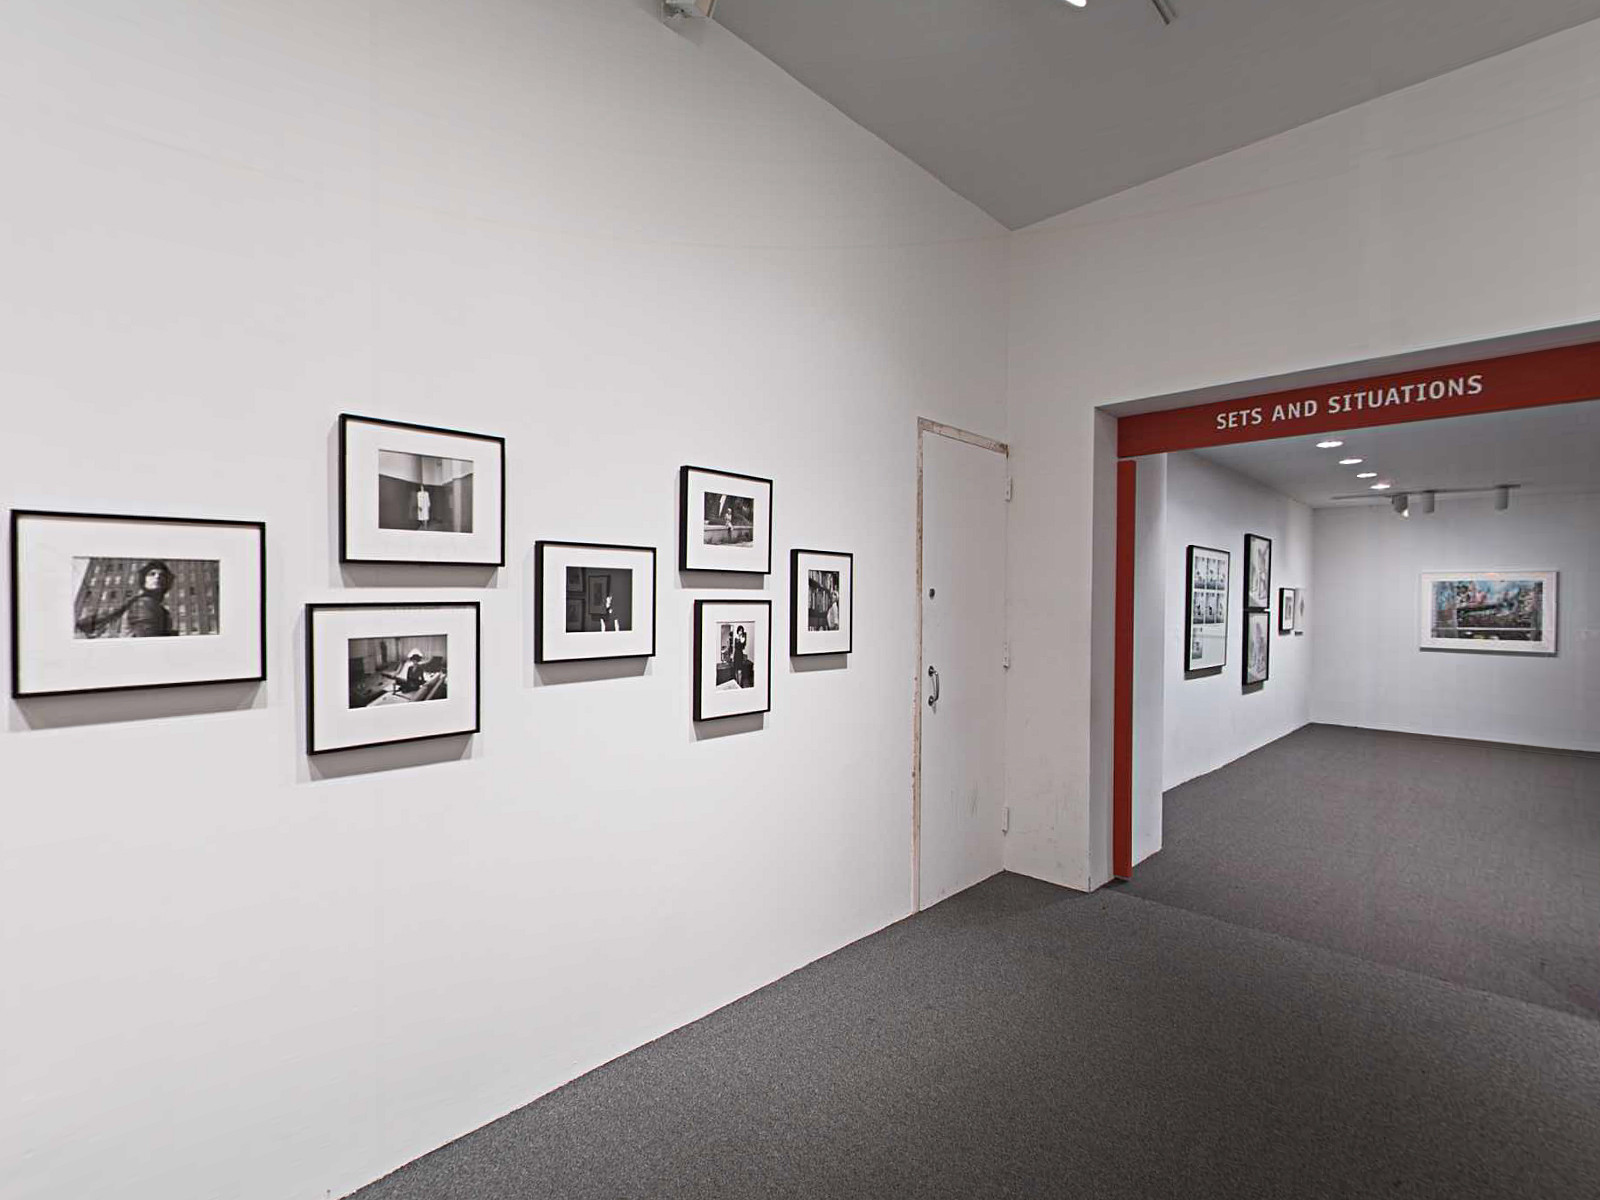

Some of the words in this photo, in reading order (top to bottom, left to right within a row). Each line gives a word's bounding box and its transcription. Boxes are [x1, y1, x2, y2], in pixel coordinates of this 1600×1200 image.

[1216, 408, 1262, 430] SETS
[1271, 400, 1318, 422] AND
[1328, 375, 1483, 414] SITUATIONS
